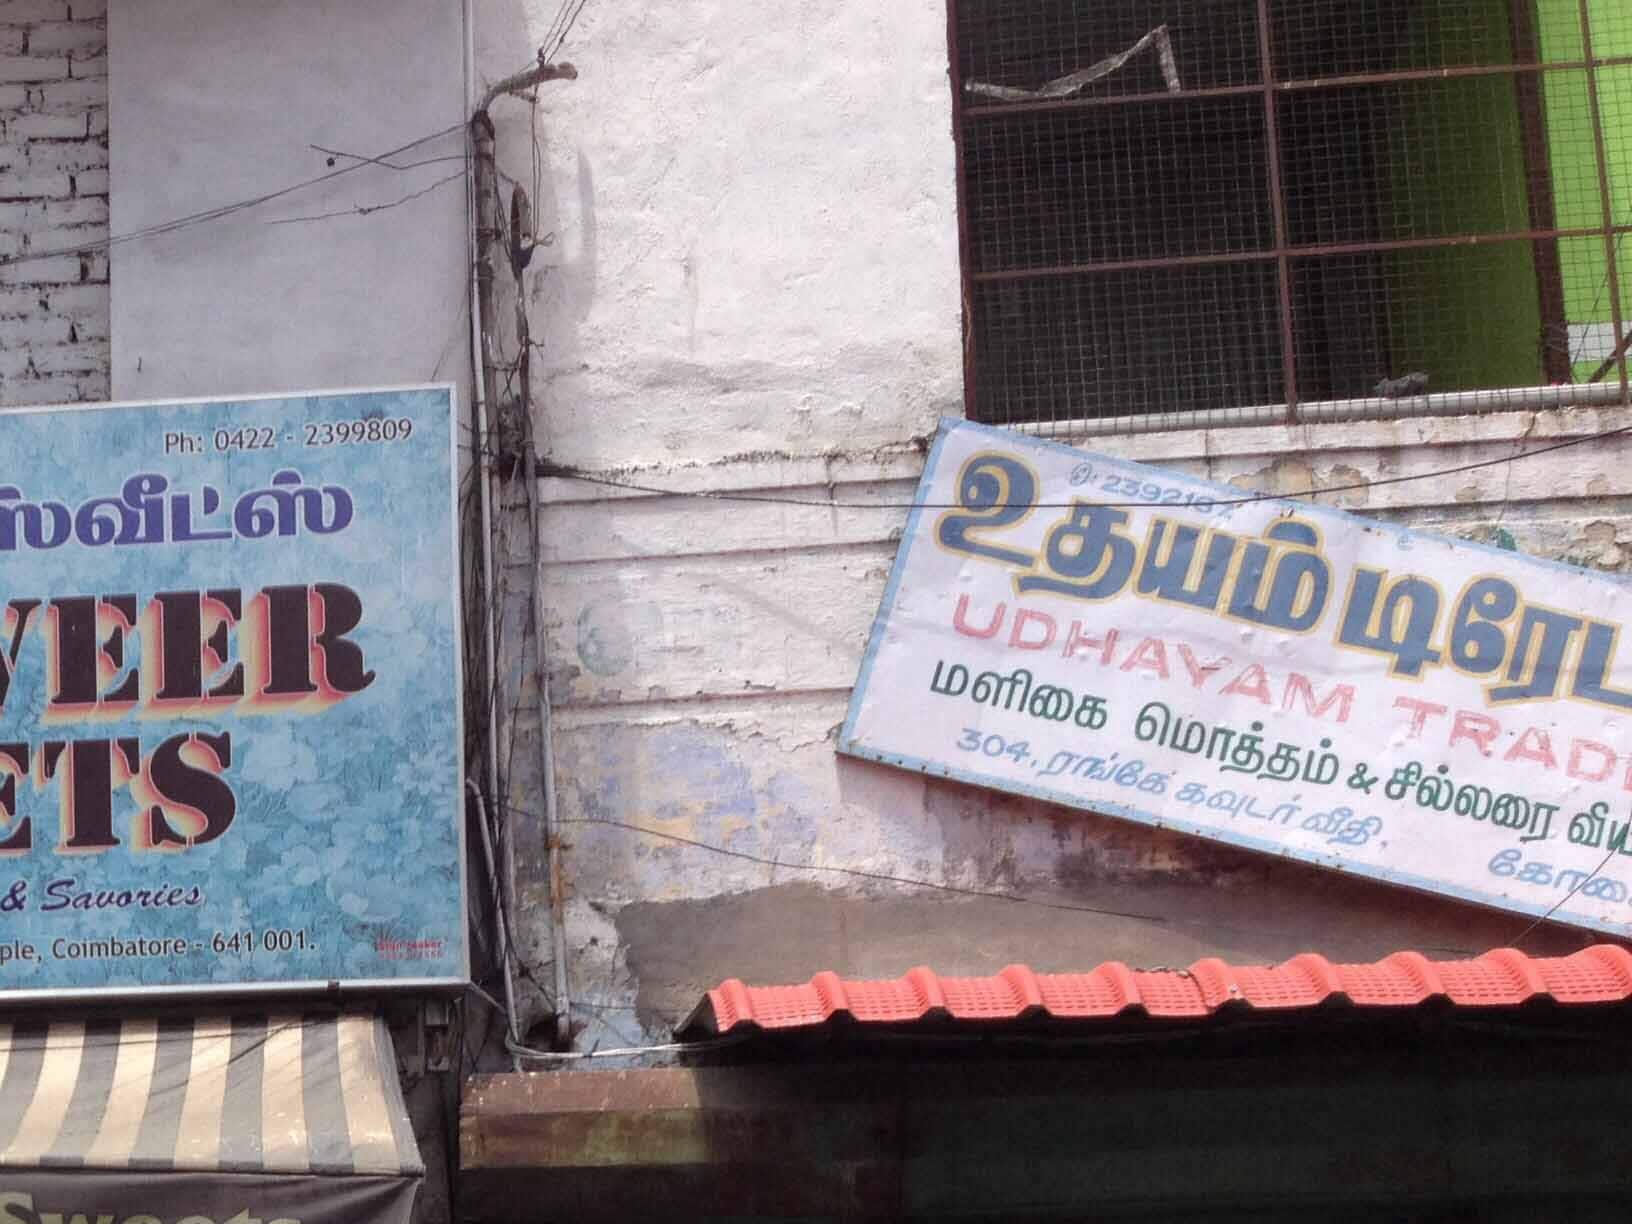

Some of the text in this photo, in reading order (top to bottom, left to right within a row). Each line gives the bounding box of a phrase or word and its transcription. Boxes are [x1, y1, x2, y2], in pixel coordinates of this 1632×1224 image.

[165, 432, 203, 453] Ph:
[215, 428, 274, 450] 0422
[305, 418, 412, 445] 2399809
[935, 449, 1330, 633] உதயம்
[931, 661, 1108, 729] மளிகை
[1134, 700, 1340, 785] மொத்தம்
[1347, 762, 1378, 794] &
[951, 594, 1632, 792] UDHAYAM TRAD
[0, 880, 27, 912] &
[40, 880, 203, 912] Savories
[52, 935, 187, 962] Coimbatore
[212, 932, 254, 954] 641
[264, 930, 314, 952] 001.
